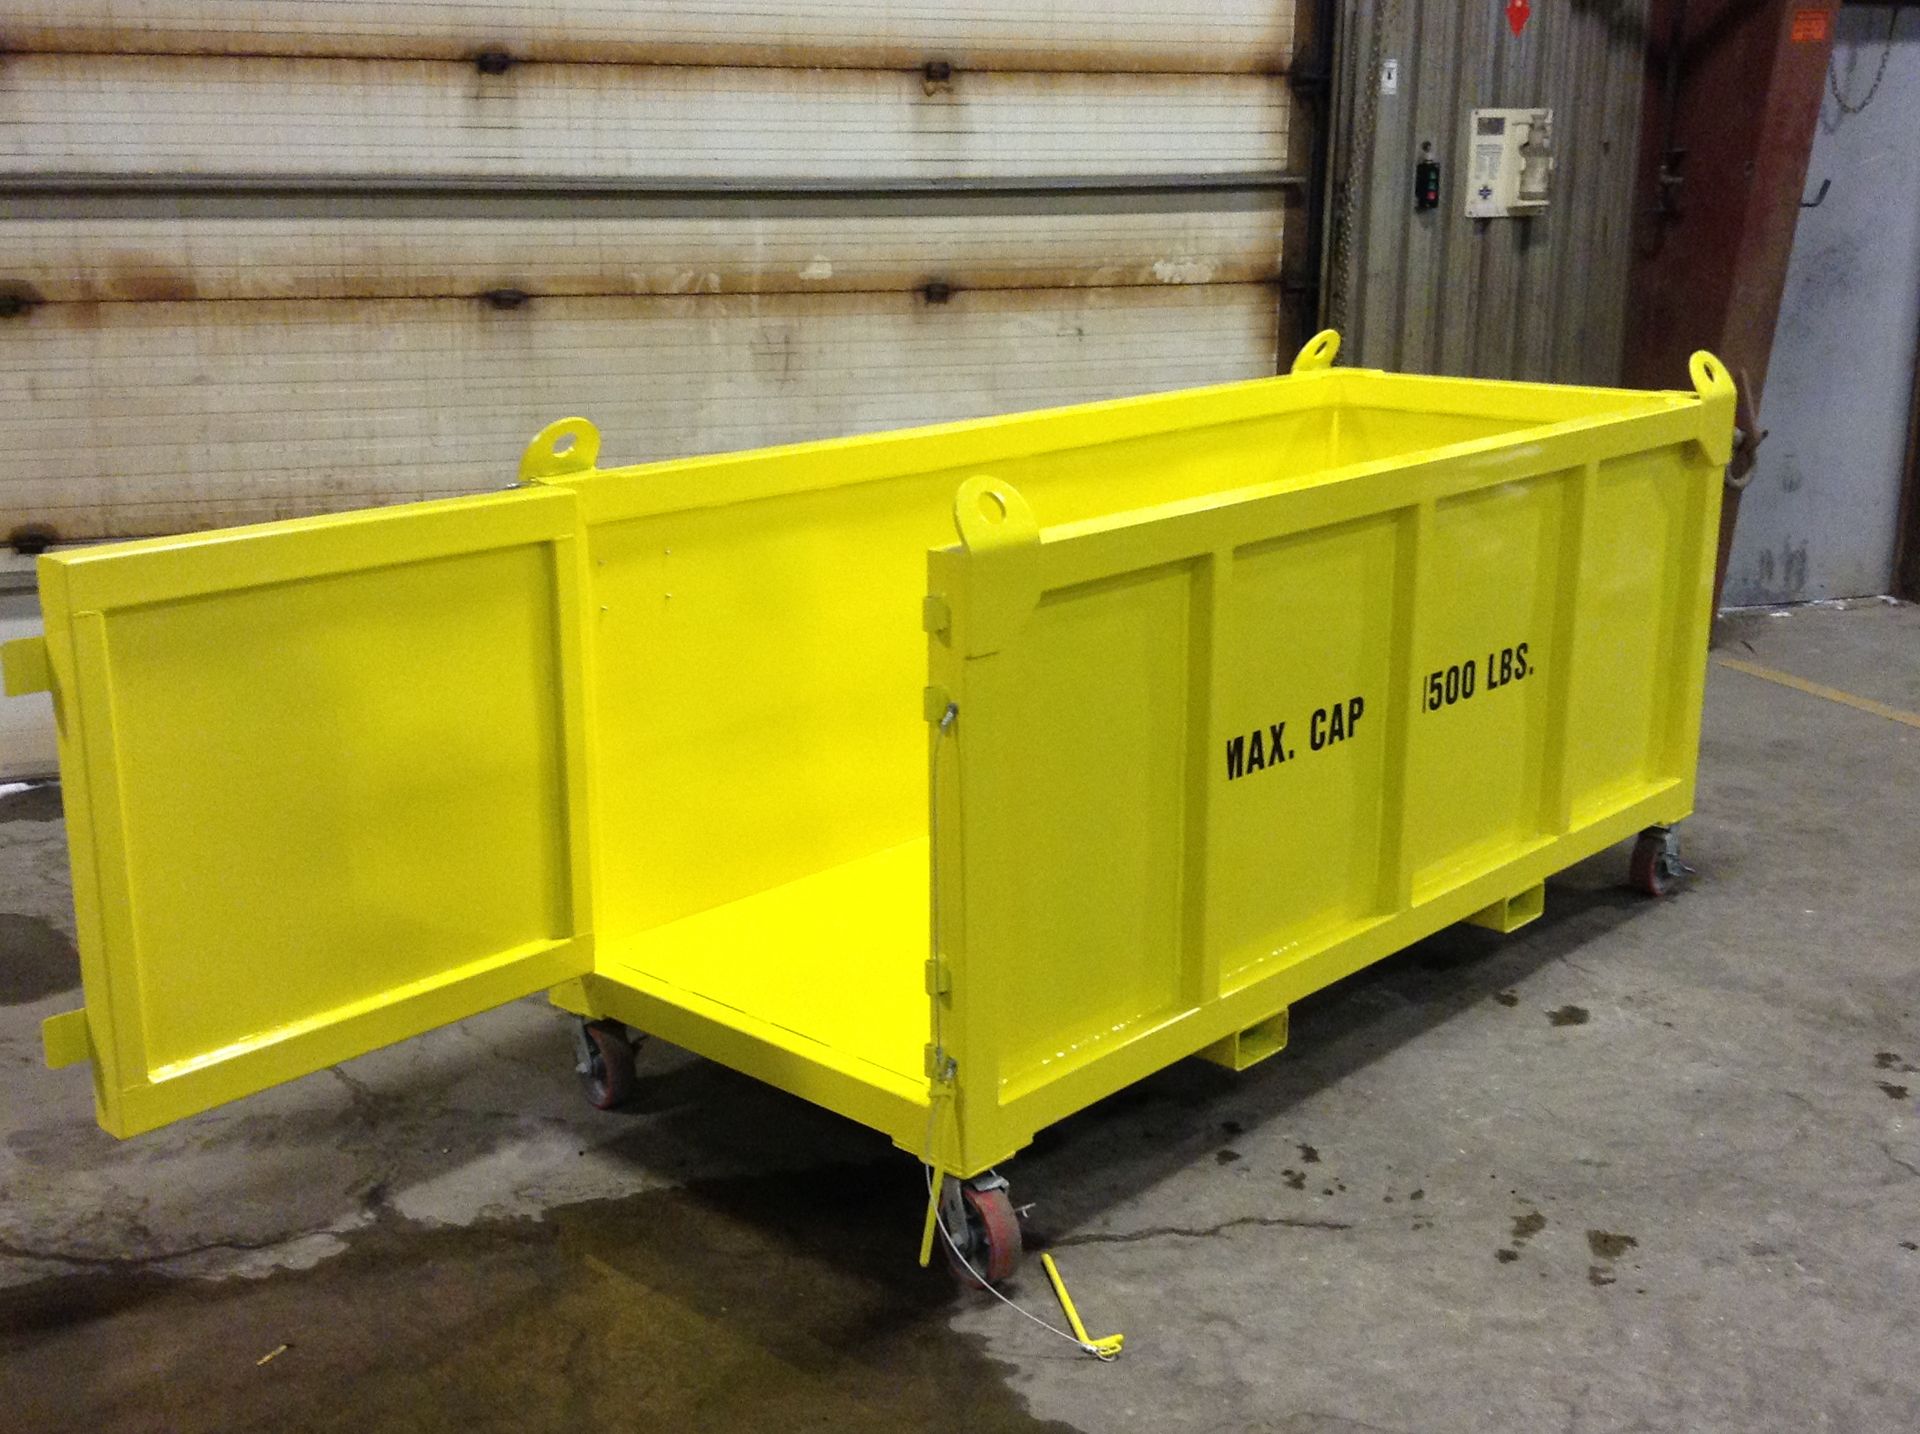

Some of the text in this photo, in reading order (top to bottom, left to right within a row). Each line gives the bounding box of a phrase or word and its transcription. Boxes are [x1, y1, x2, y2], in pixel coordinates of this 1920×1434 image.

[1226, 721, 1295, 780] MAX.
[1309, 696, 1365, 751] CAP
[1486, 642, 1535, 690] LBS.
